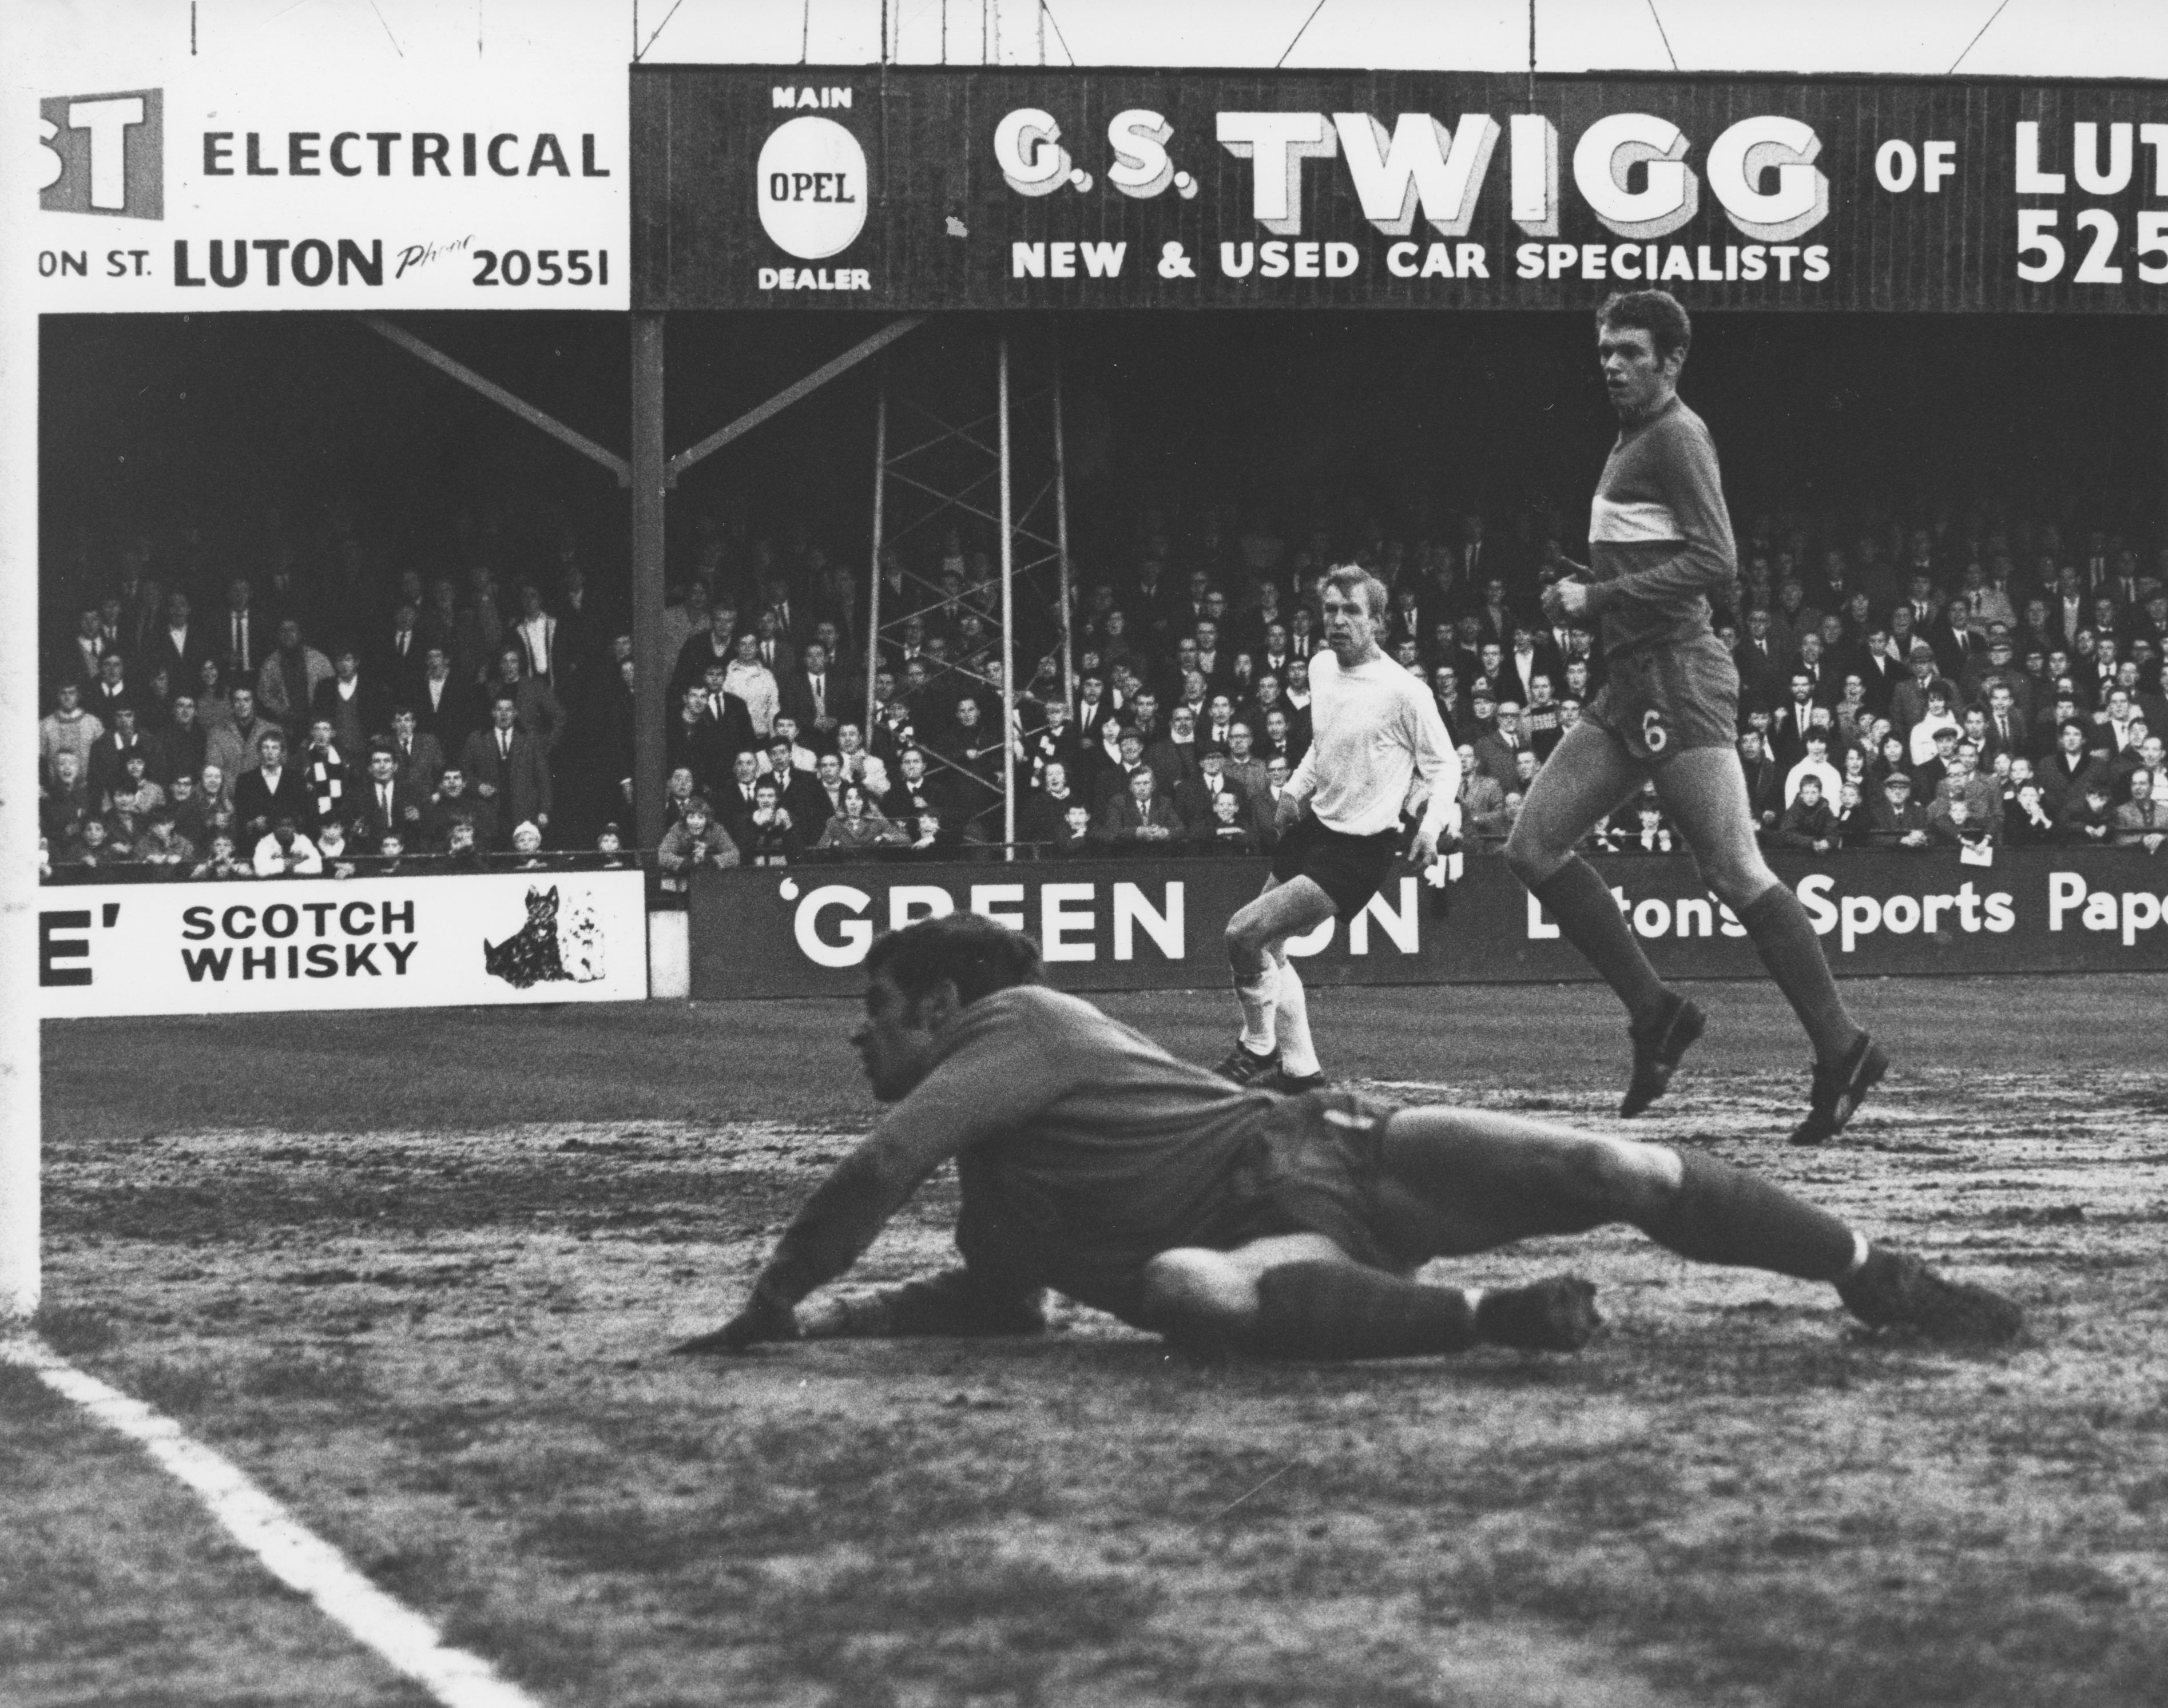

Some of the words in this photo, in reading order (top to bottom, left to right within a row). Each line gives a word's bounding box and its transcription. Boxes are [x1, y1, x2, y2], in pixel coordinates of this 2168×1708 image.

[772, 86, 853, 109] MAIN
[204, 132, 610, 177] ELECTRICAL
[770, 172, 855, 203] OPEL
[1216, 111, 1830, 241] TWIGG
[1875, 139, 1956, 193] OF
[106, 250, 152, 277] ST.
[174, 239, 383, 288] LUTON
[472, 249, 608, 286] 20551
[758, 267, 872, 291] DEALER
[1012, 241, 1127, 278] NEW
[1157, 241, 1196, 279] &
[1220, 241, 1360, 278] USED
[1386, 241, 1490, 279] CAR
[1516, 240, 1830, 282] SPECIALISTS
[1642, 709, 1667, 752] 6
[181, 900, 415, 941] SCOTCH
[1796, 873, 2015, 952] Sports
[2049, 872, 2168, 946] Pap
[181, 941, 418, 982] WHISKY
